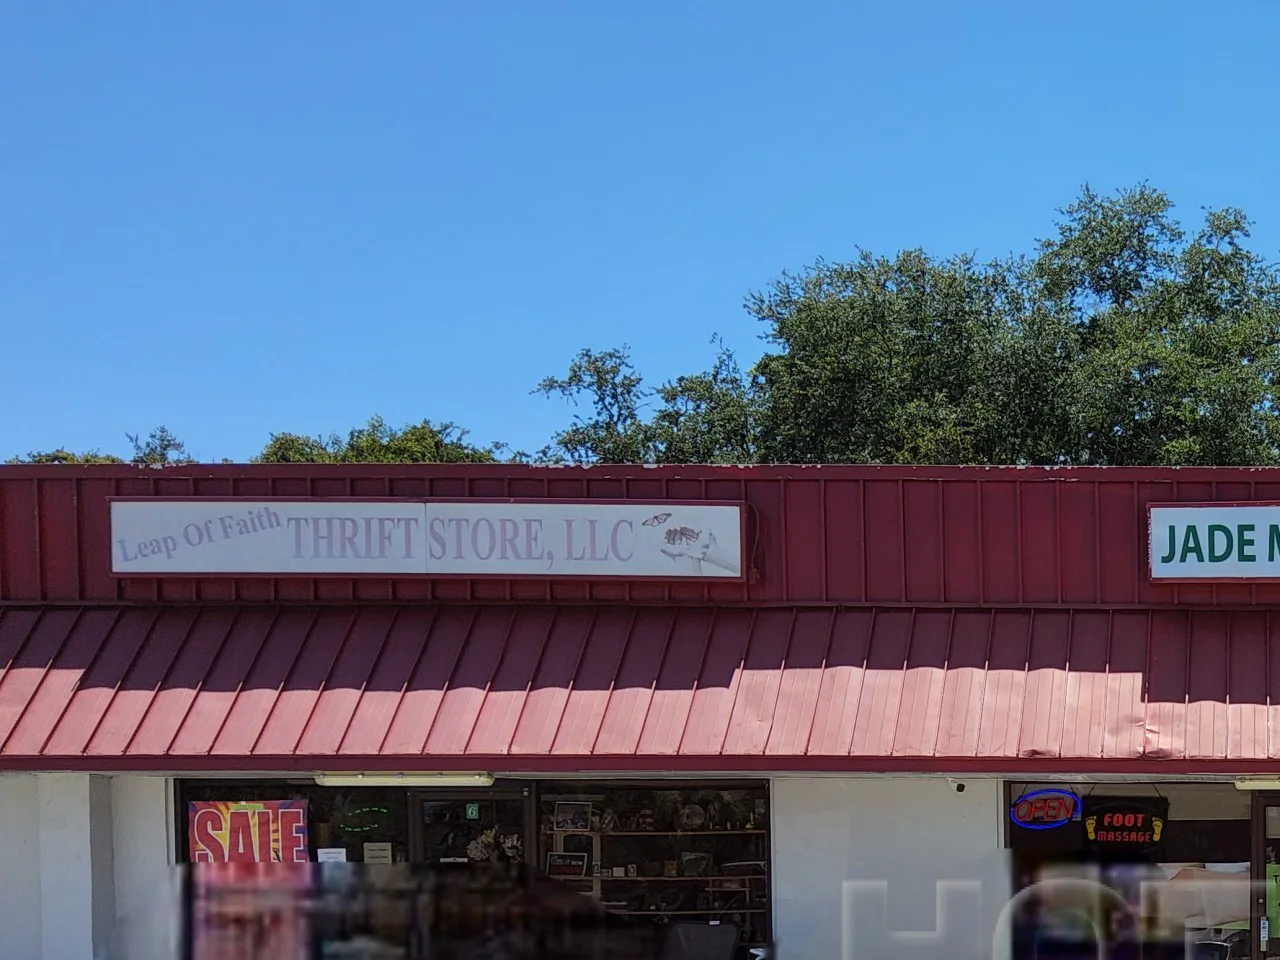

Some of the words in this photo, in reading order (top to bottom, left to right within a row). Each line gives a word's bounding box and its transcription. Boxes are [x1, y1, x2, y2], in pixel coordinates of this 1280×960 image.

[117, 532, 177, 562] Leap
[183, 519, 213, 547] Of
[218, 506, 281, 539] Faith
[286, 517, 419, 559] THRIFT
[429, 516, 554, 571] STORE,
[563, 518, 634, 562] LLC
[1161, 524, 1256, 563] JADE
[468, 806, 477, 817] 6
[1015, 799, 1075, 821] OPEN
[1104, 813, 1145, 827] FOOT
[1097, 831, 1150, 842] MASSAGE
